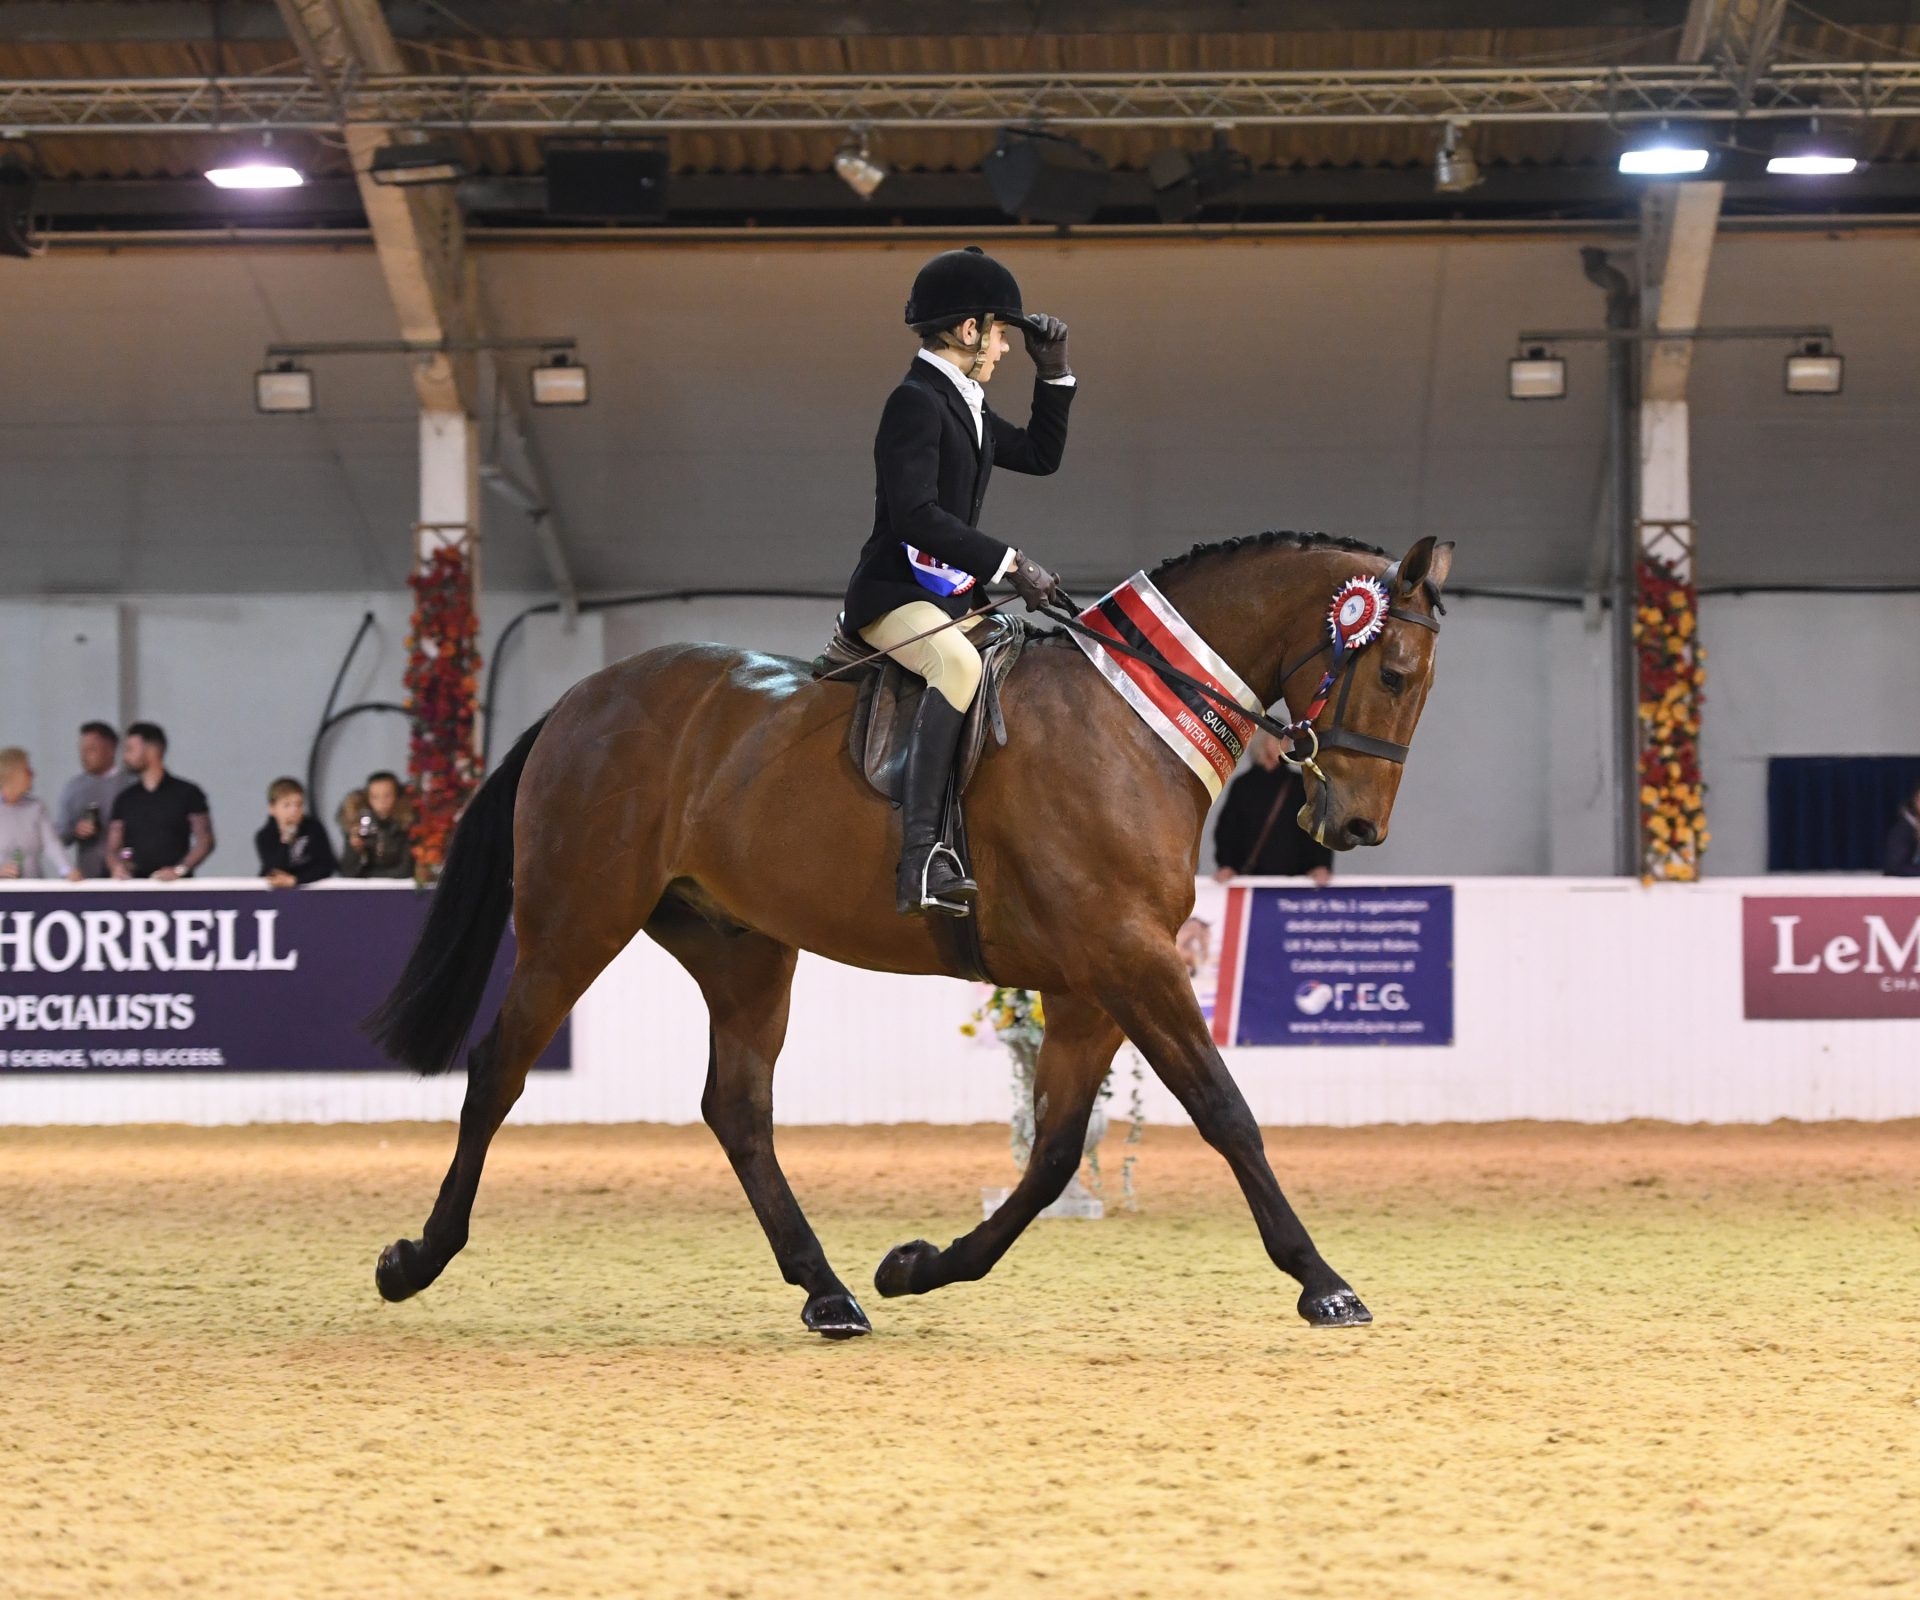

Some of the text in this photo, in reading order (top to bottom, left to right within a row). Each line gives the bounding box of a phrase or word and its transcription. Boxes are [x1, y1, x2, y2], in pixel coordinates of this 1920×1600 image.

[1175, 710, 1207, 744] WINTER
[1203, 710, 1242, 755] SAUNTERS
[10, 1049, 88, 1069] SCIENCE,
[89, 1049, 140, 1067] YOUR
[142, 1048, 226, 1067] SUCCESS.
